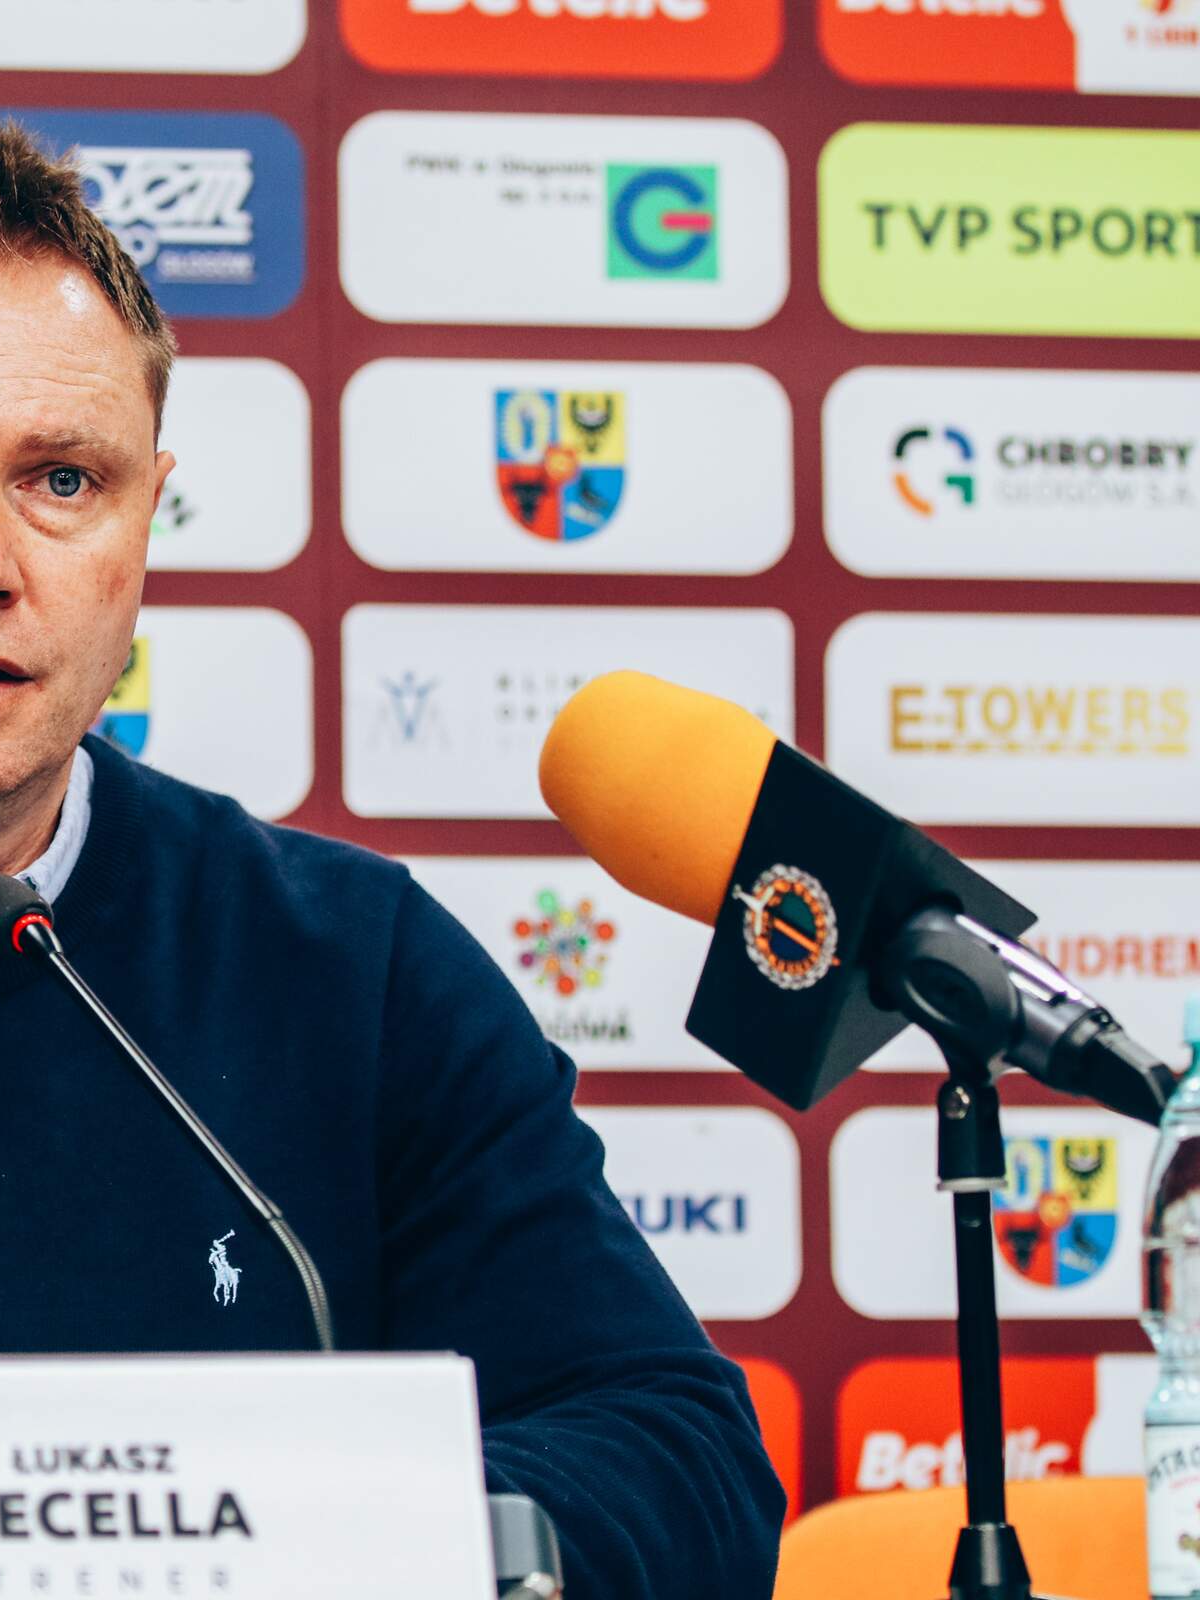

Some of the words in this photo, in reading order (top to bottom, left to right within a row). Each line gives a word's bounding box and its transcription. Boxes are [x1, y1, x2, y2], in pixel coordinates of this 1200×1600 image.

[863, 203, 991, 250] TVP
[1011, 206, 1200, 256] SPORT
[998, 437, 1191, 469] CHROBRY
[890, 685, 1190, 753] E-TOWERS
[620, 1195, 748, 1235] UKI
[11, 1444, 174, 1475] ŁUKASZ
[855, 1427, 1071, 1491] Betlic
